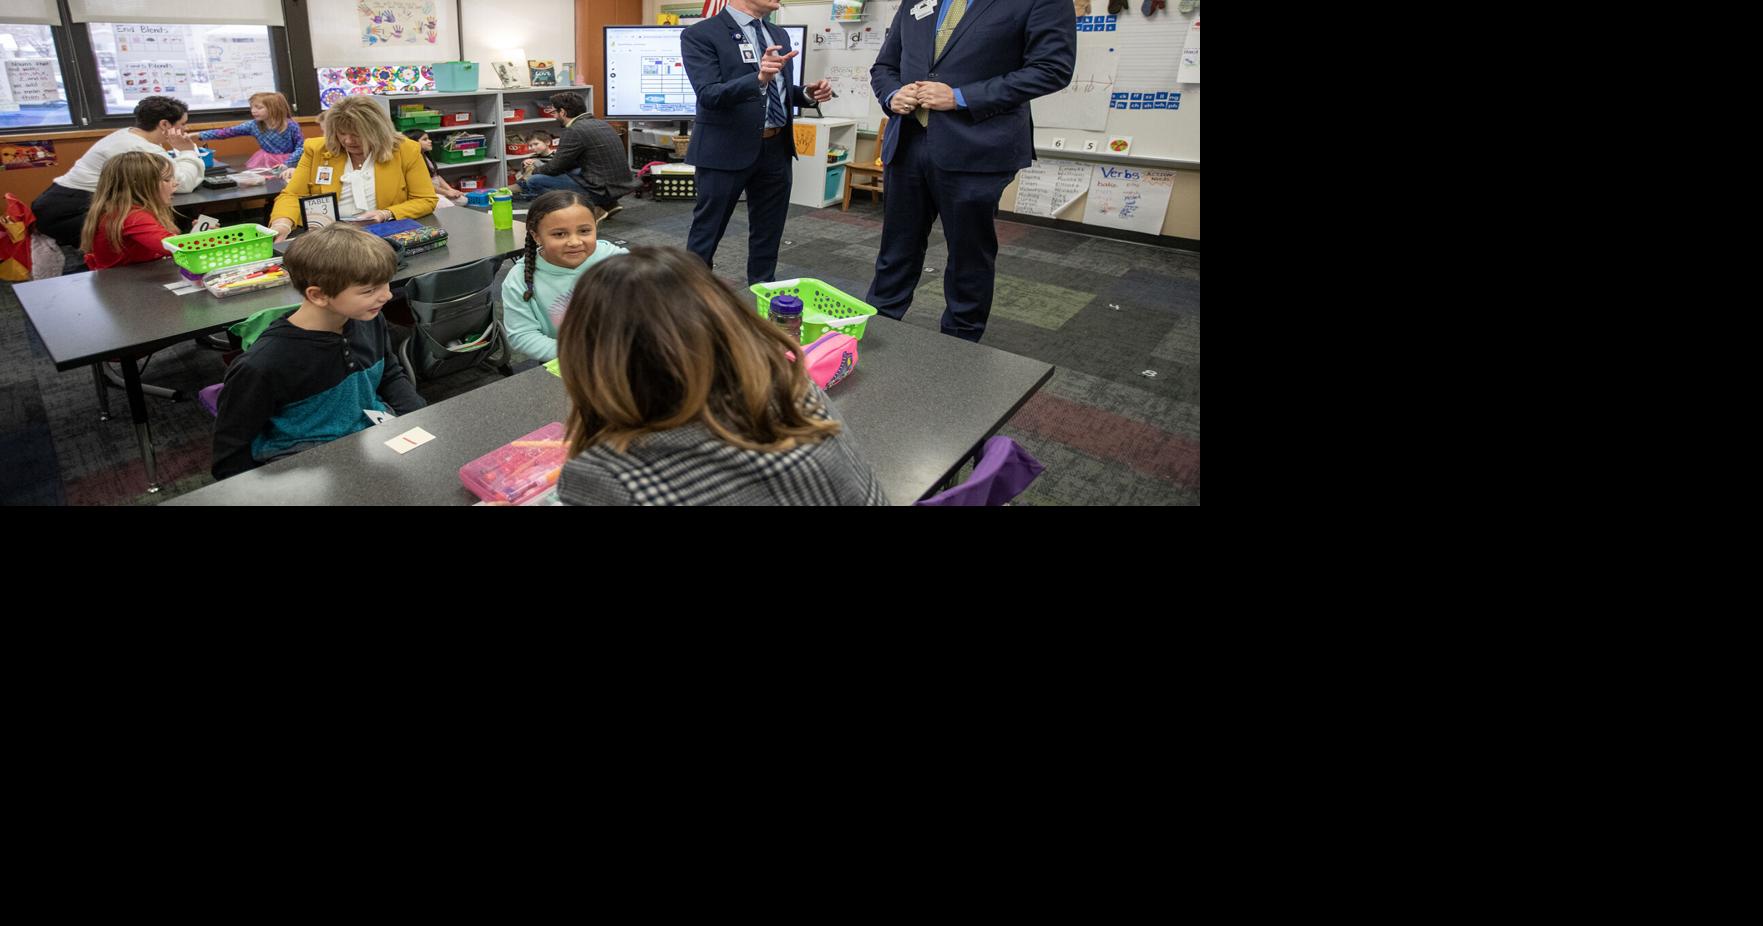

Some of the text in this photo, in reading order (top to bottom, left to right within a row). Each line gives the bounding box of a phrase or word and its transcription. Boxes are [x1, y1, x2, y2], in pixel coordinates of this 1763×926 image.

[140, 25, 169, 34] Blends
[815, 33, 824, 43] b
[851, 32, 861, 42] d
[1055, 139, 1062, 147] 6
[1087, 142, 1094, 150] 5
[1101, 166, 1140, 180] Verbs
[308, 196, 331, 207] TABLE
[321, 204, 329, 215] 3
[199, 221, 210, 232] 0
